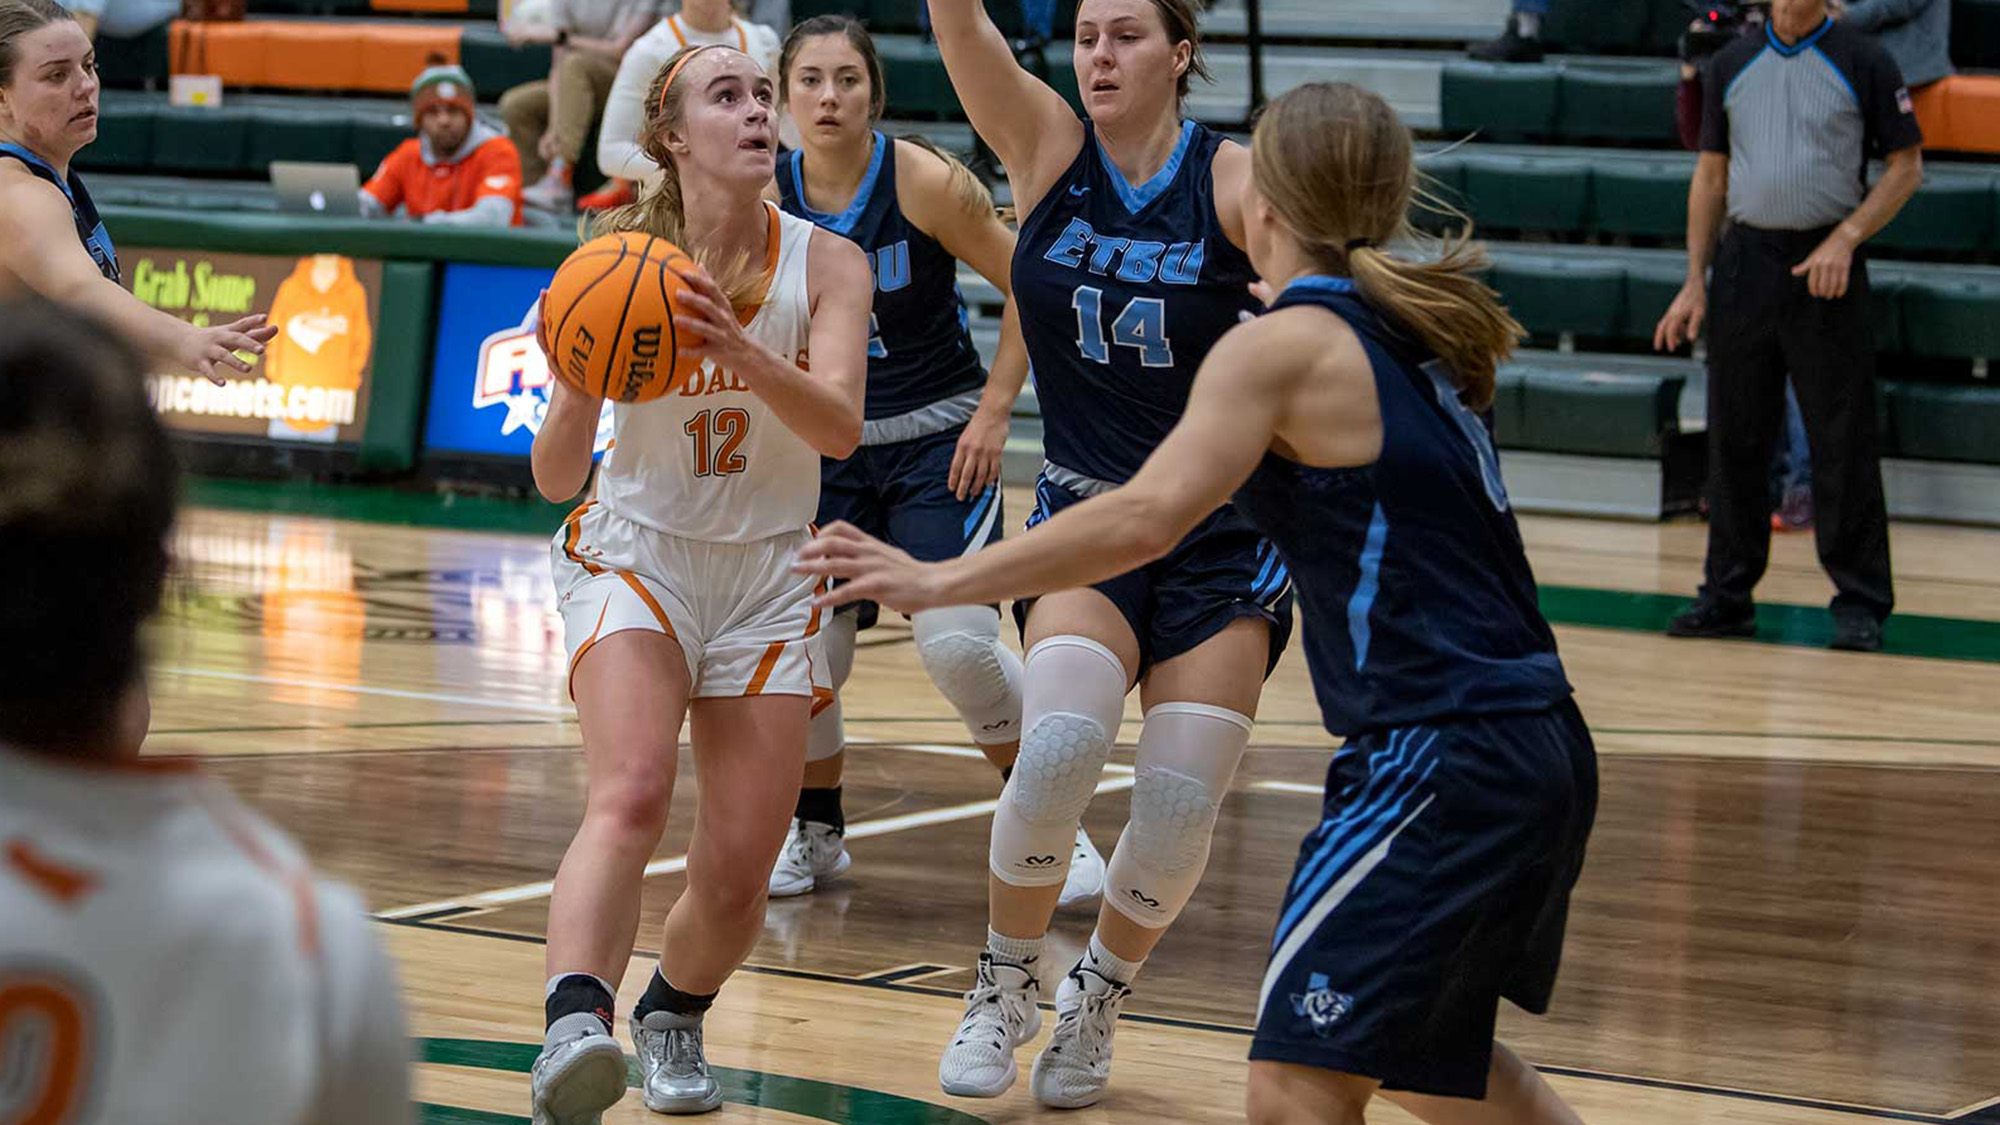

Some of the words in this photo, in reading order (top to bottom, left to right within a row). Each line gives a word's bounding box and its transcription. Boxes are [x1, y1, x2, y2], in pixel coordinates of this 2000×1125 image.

[1044, 217, 1204, 285] ETBU
[133, 259, 190, 308] Grab
[190, 261, 256, 313] Some
[1072, 285, 1174, 367] 14
[684, 407, 750, 478] 12
